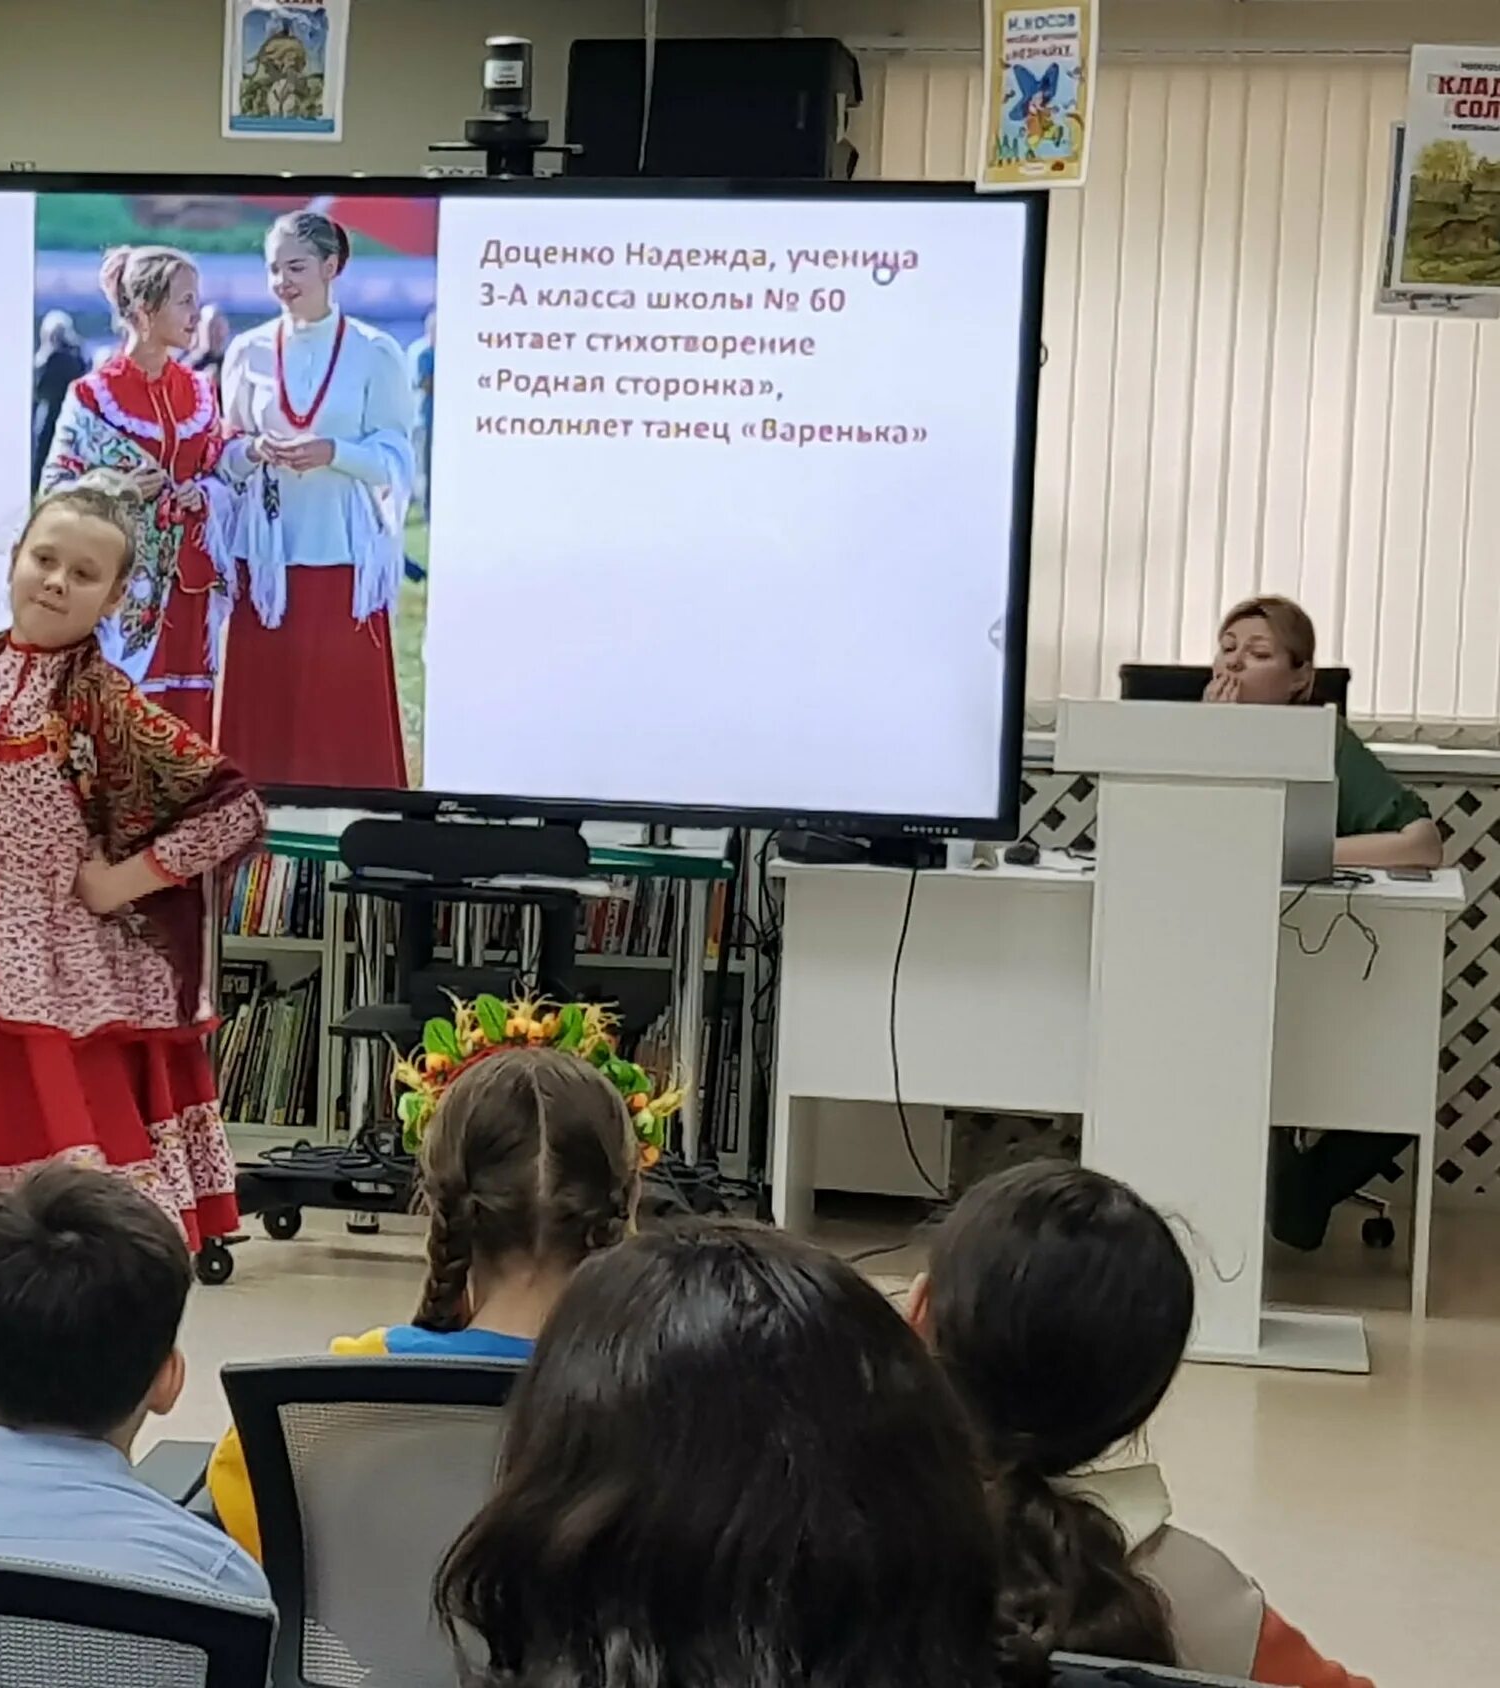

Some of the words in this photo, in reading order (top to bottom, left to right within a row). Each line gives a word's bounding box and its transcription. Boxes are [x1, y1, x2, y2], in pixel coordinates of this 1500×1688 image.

[479, 239, 615, 269] Доценко
[625, 242, 776, 272] Надежда,
[786, 248, 920, 272] ученица
[480, 282, 528, 307] 3-А
[537, 288, 636, 309] класса
[646, 290, 753, 310] школы
[809, 287, 846, 313] 60
[477, 331, 577, 351] читает
[585, 331, 816, 359] стихотворение
[477, 368, 605, 398] «Родная
[615, 375, 784, 403] сторонка»,
[476, 415, 634, 438] исполняет
[642, 419, 731, 444] танец
[741, 418, 928, 448] «Варенька»
